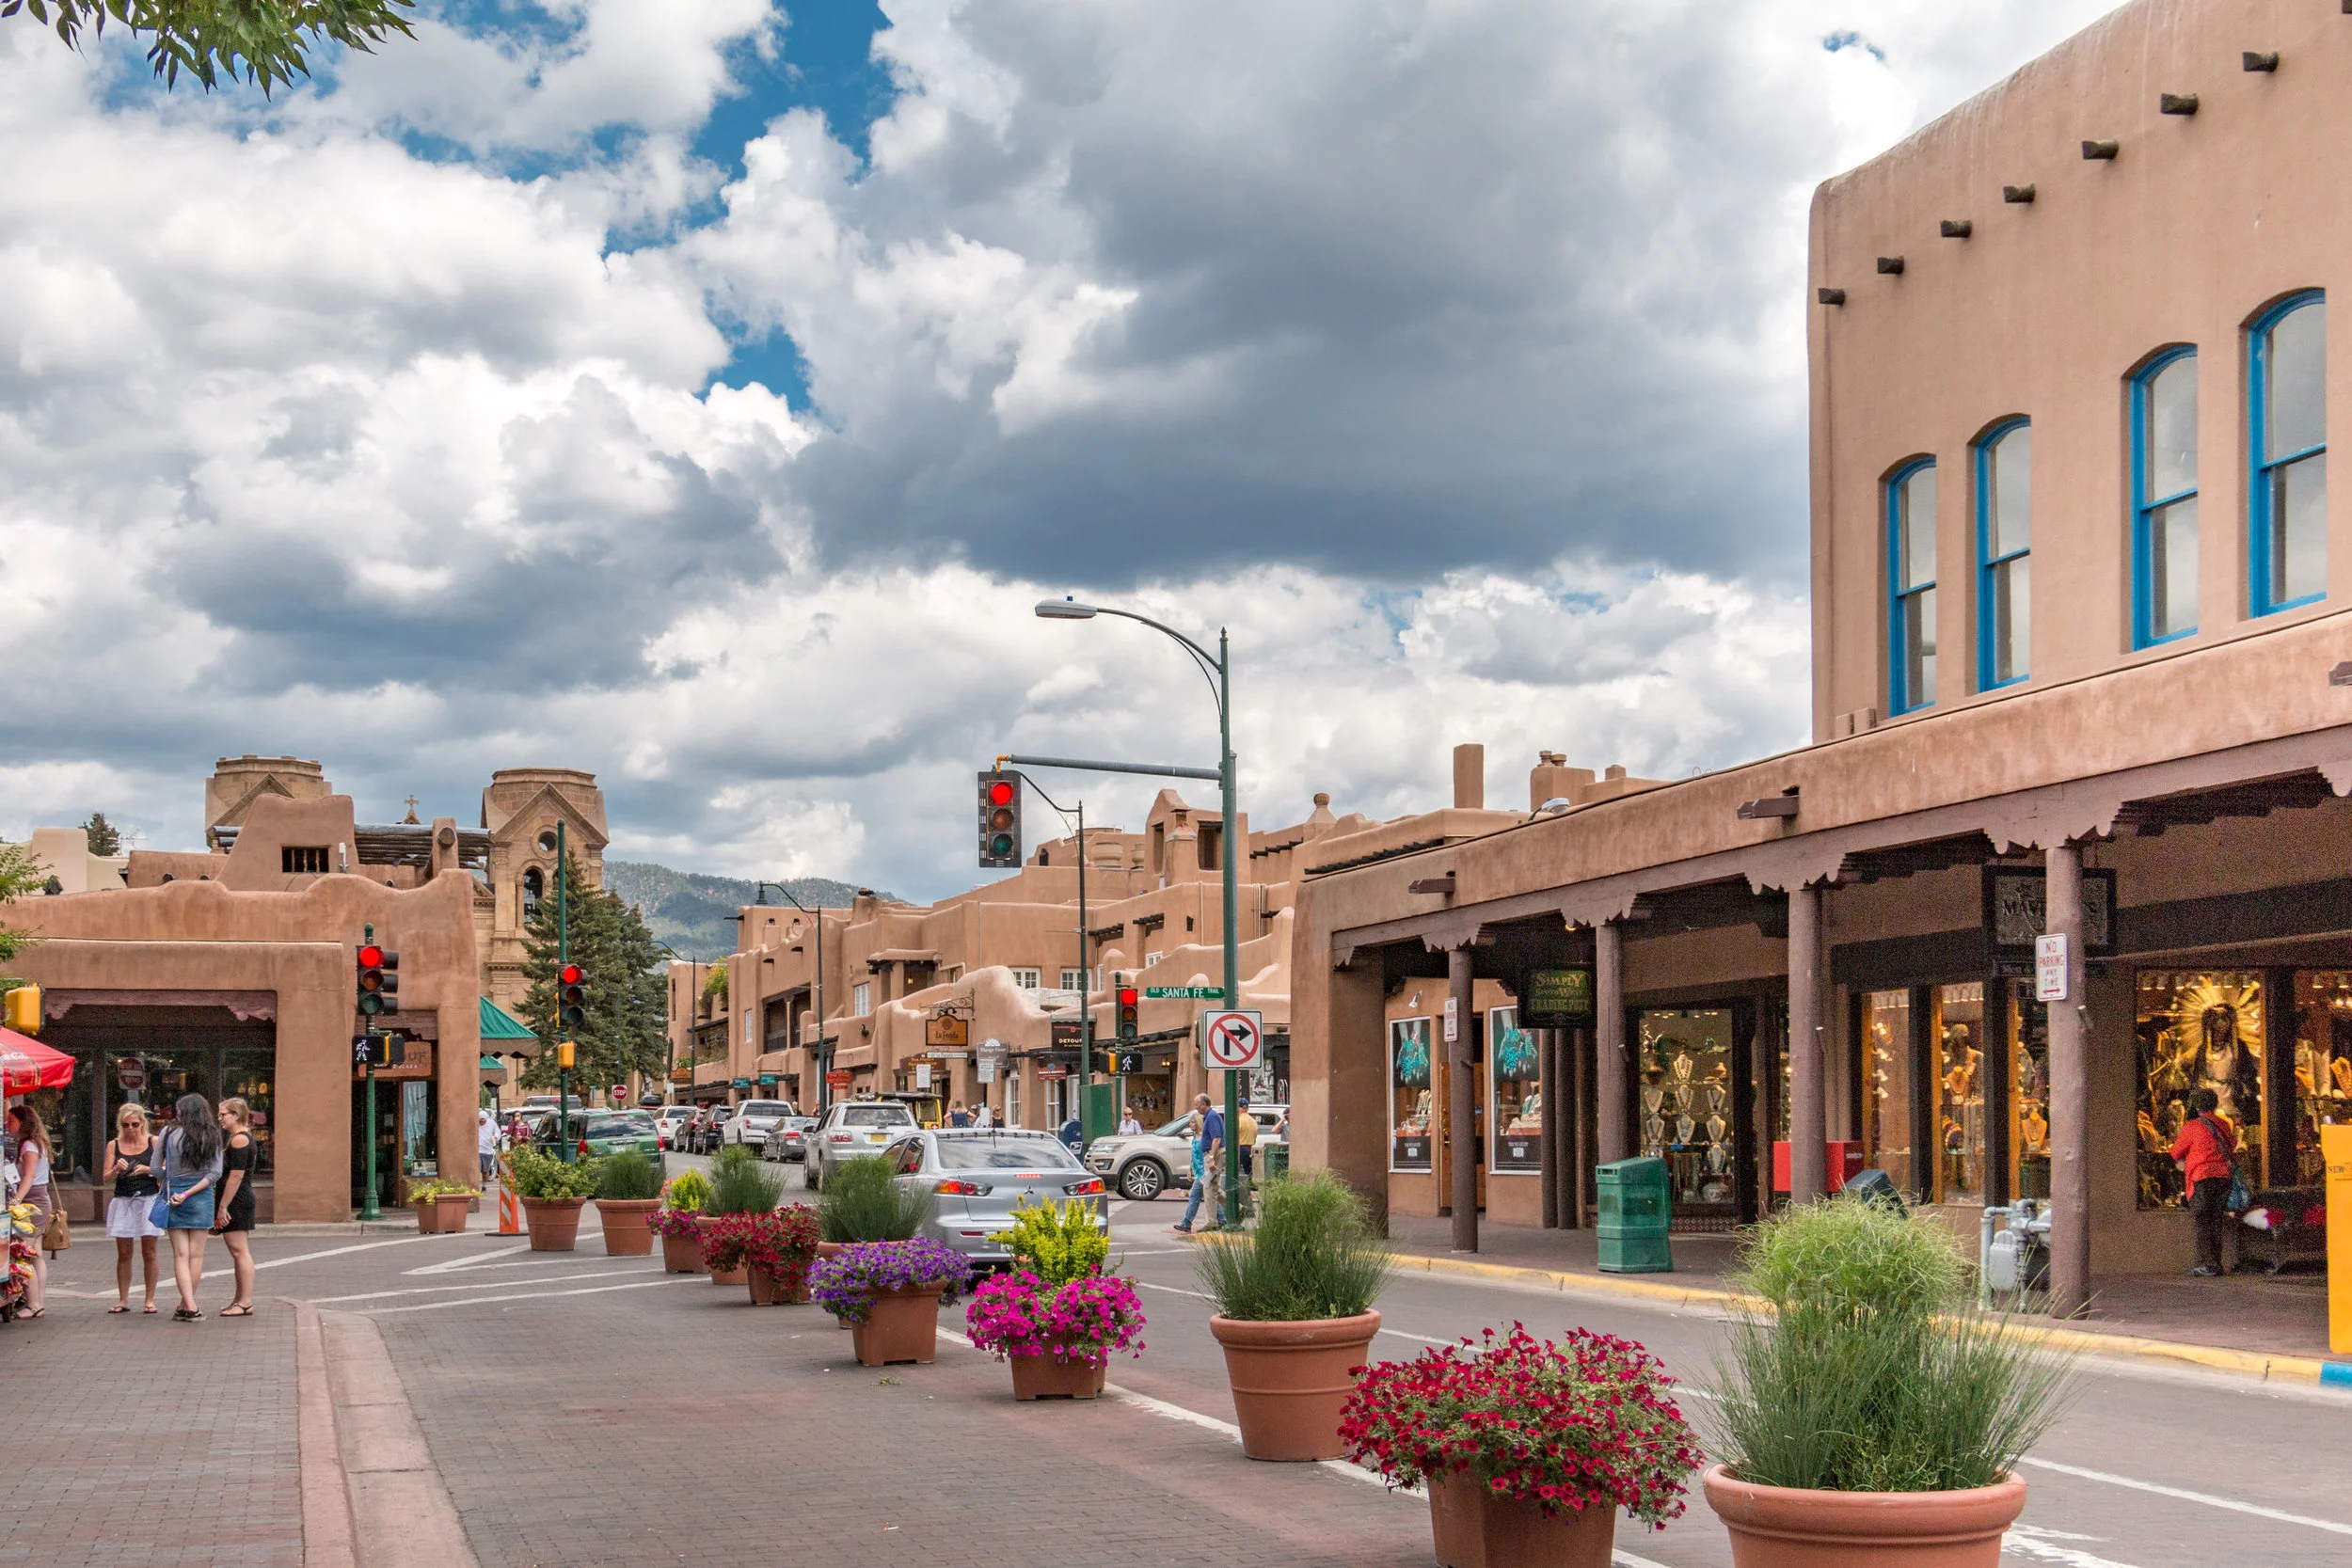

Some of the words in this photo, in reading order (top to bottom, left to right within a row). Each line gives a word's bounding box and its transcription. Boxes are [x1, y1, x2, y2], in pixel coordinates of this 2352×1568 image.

[2045, 942, 2058, 953] NO
[2039, 955, 2064, 967] PARKING
[2044, 977, 2058, 987] TIME
[1162, 988, 1190, 998] SANTA
[1193, 988, 1204, 998] FE
